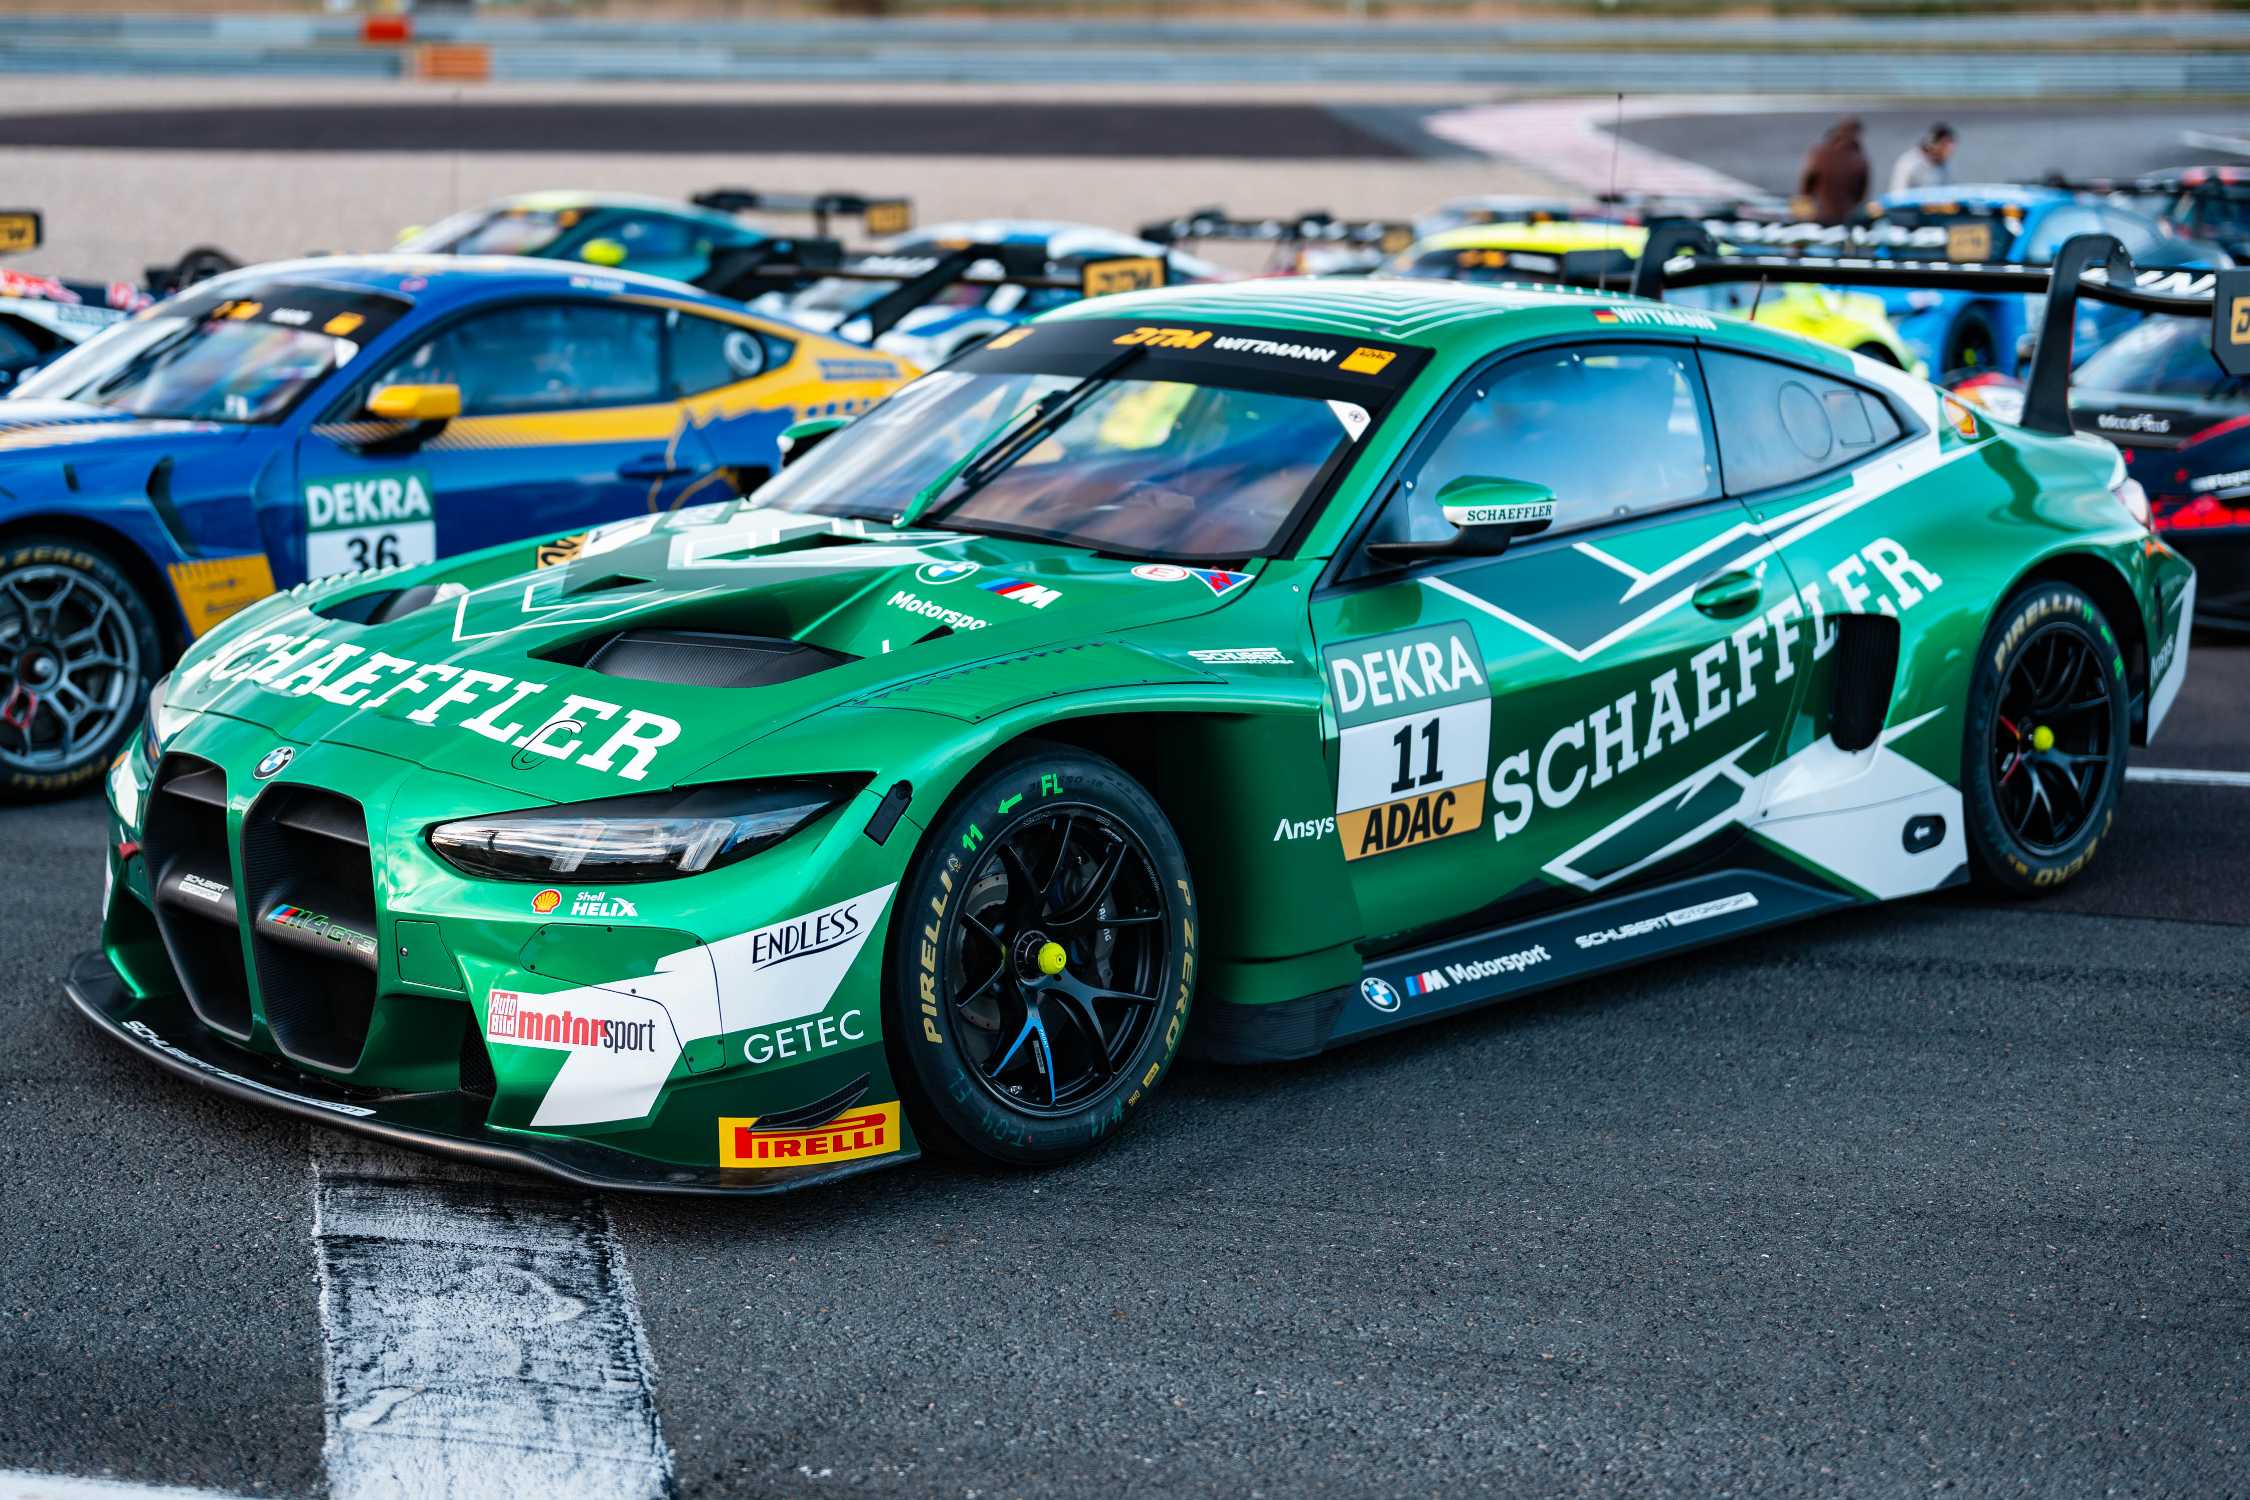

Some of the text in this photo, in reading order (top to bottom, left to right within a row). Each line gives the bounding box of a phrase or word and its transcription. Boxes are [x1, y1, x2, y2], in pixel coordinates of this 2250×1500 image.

[1112, 327, 1214, 350] DTM
[1610, 306, 1717, 331] WITTMANN
[1213, 335, 1337, 363] WITTMANN
[305, 475, 432, 528] DEKRA
[1466, 504, 1553, 521] SCHAEFFLER
[347, 532, 401, 574] 36
[886, 590, 993, 631] Motorspo
[1994, 593, 2079, 673] PIRELLI
[1331, 635, 1484, 714] DEKRA
[1492, 537, 1943, 842] SCHAEFFLER
[182, 633, 682, 781] SCHAEFFLER
[1390, 717, 1444, 794] 11
[1040, 773, 1064, 798] FL
[1273, 816, 1336, 842] Ansys
[1360, 789, 1456, 856] ADAC
[183, 873, 230, 894] SCHUBERT
[575, 891, 606, 901] Shell
[570, 896, 639, 917] HELIX
[751, 903, 860, 965] ENDLESS
[1575, 914, 1674, 950] SCHUBERT
[918, 870, 954, 1045] PIRELLI
[1164, 878, 1195, 1047] P ZERO
[1447, 943, 1552, 985] Motorsport
[490, 992, 517, 1015] Auto
[491, 1014, 516, 1035] Bild
[743, 1009, 865, 1064] GETEC
[734, 1112, 887, 1160] PIRELLI
